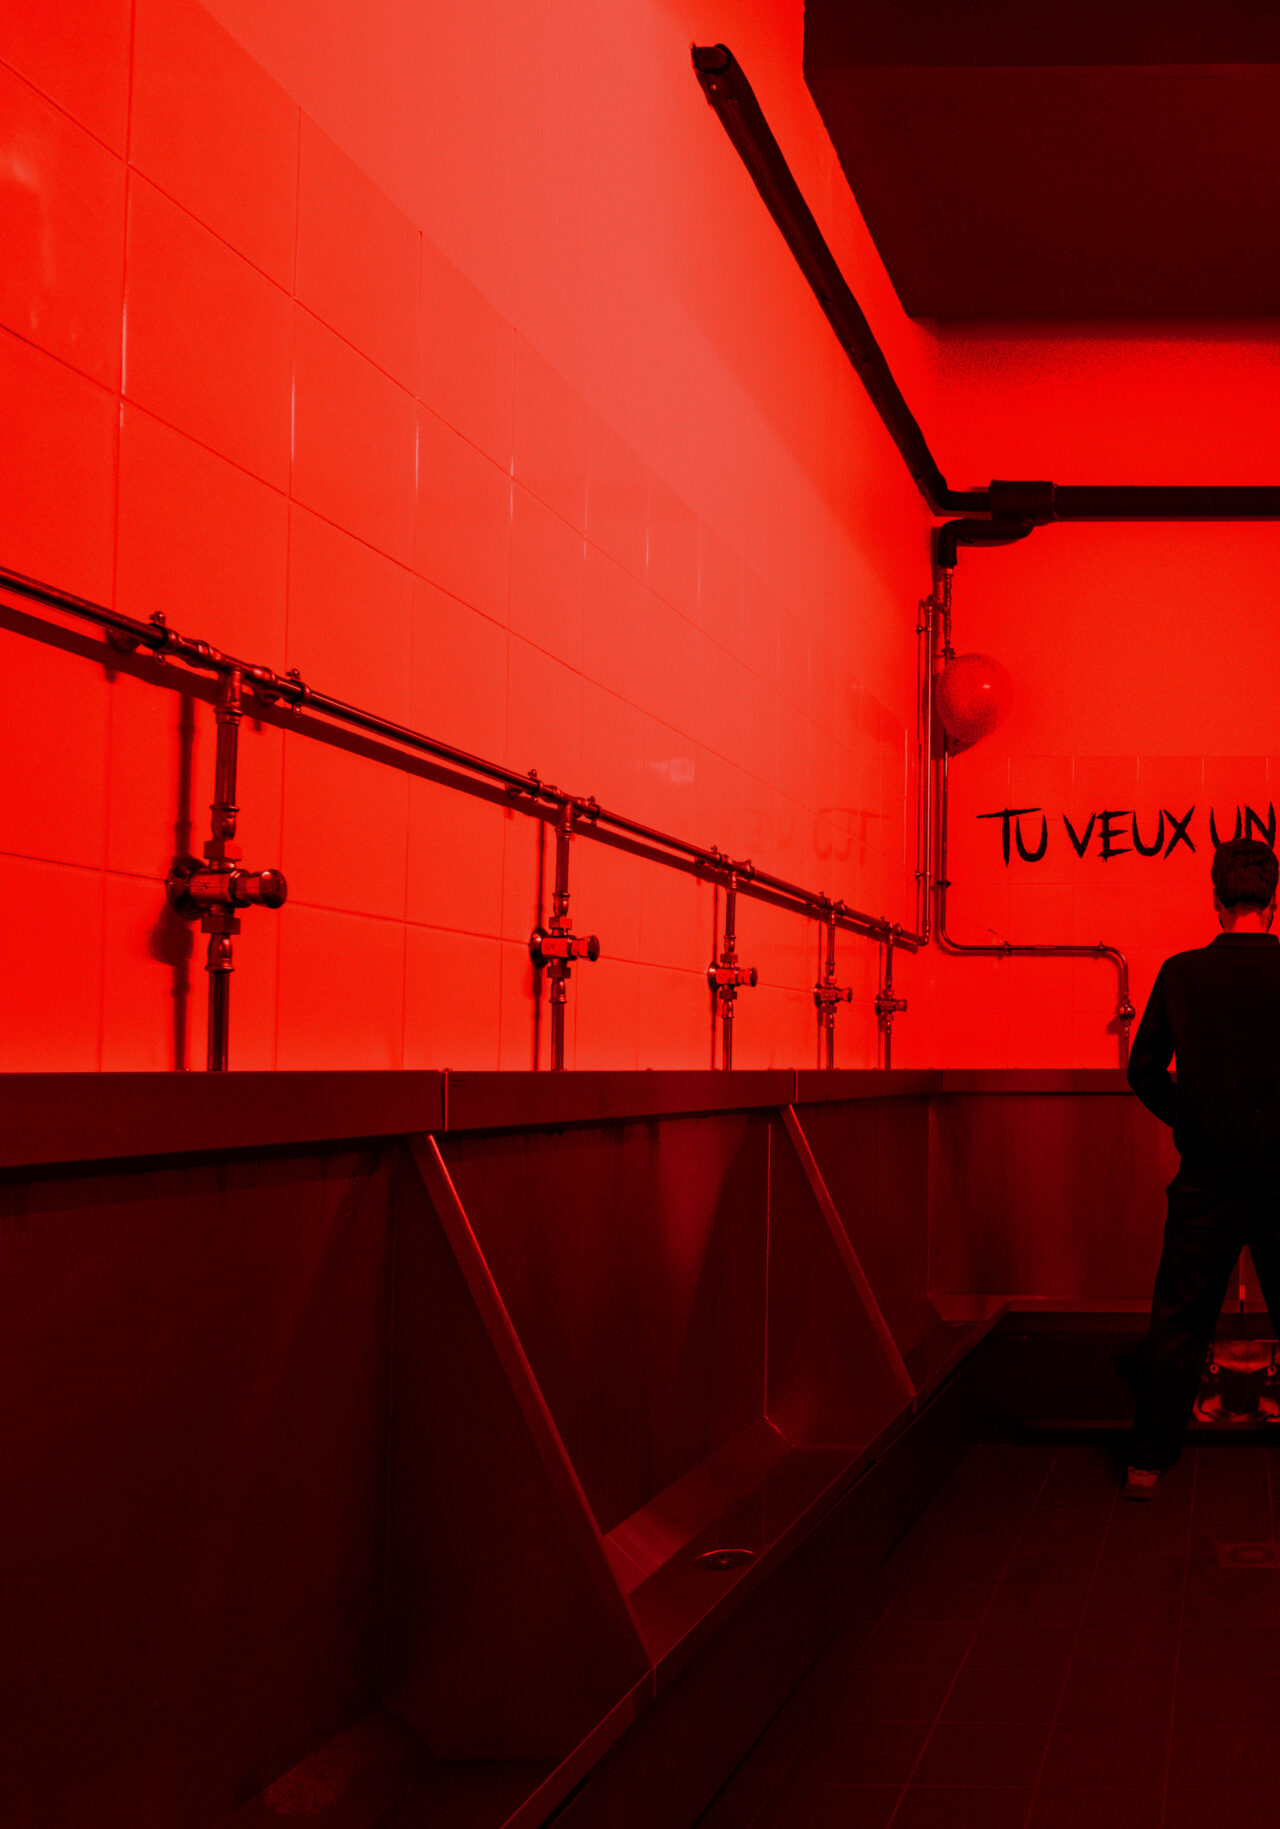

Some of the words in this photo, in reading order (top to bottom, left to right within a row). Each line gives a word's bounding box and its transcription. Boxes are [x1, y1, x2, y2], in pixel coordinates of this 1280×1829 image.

[976, 807, 1048, 867] TU
[1063, 805, 1196, 861] VEUX
[1210, 801, 1276, 851] UN
